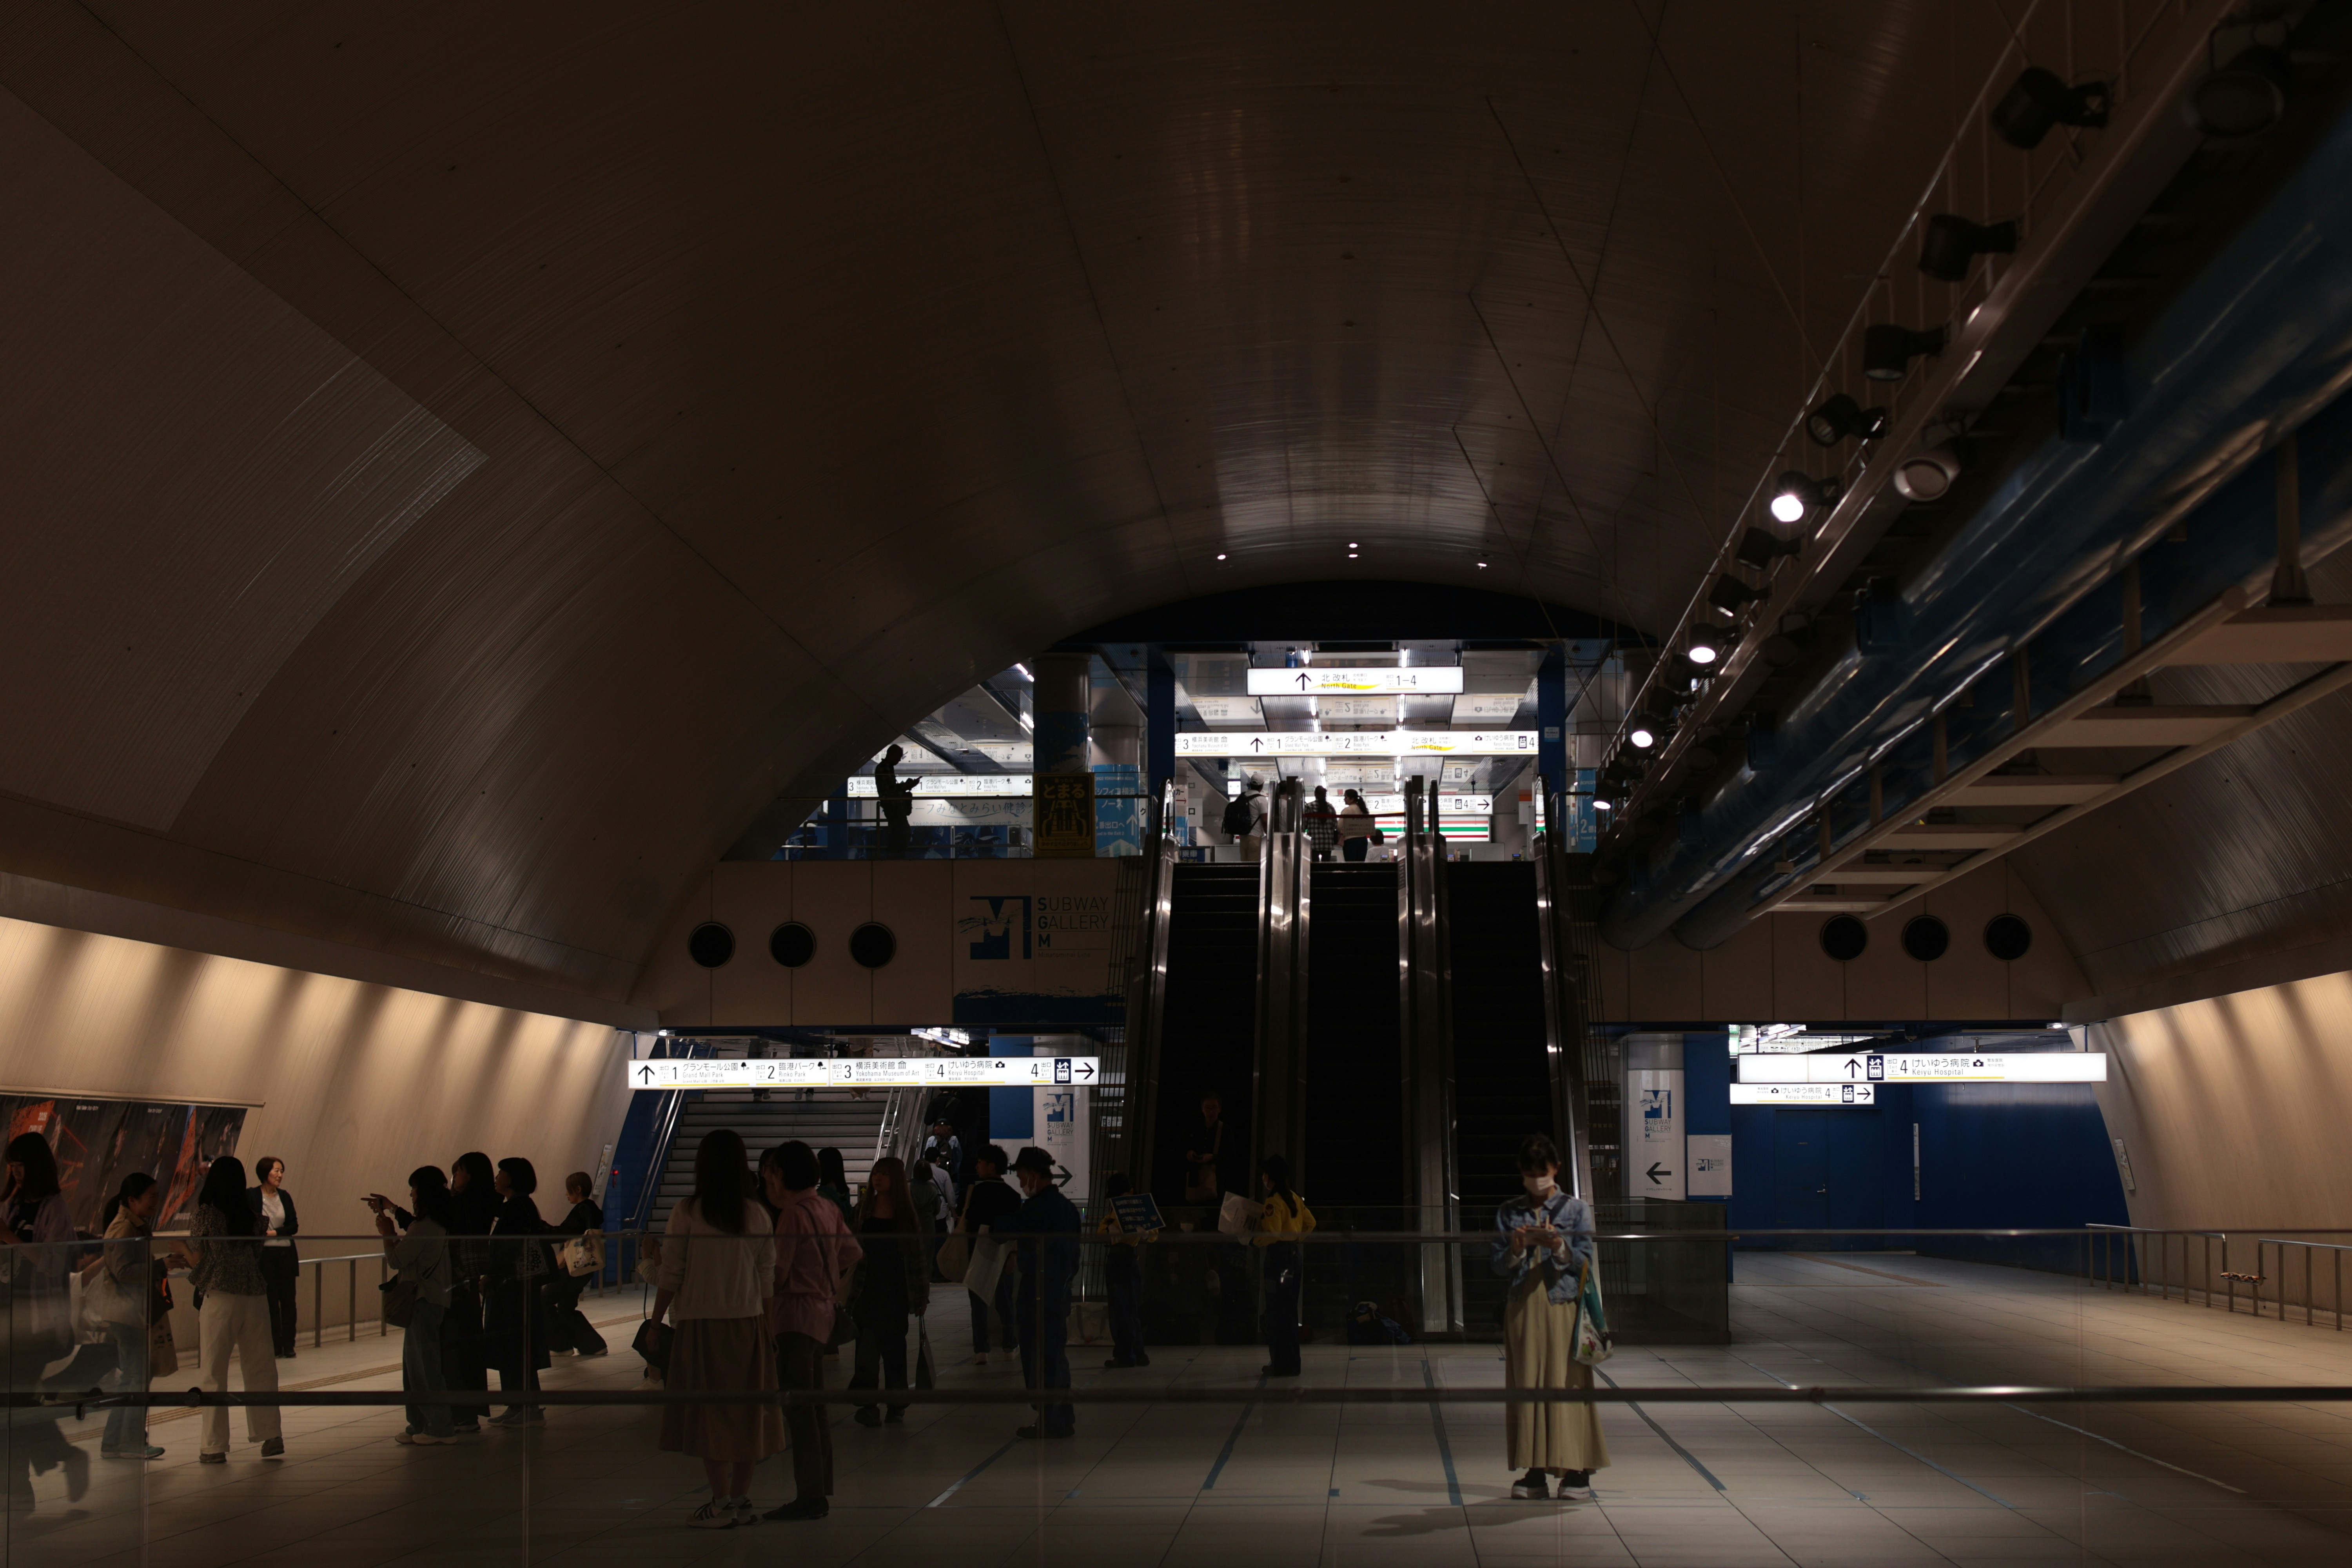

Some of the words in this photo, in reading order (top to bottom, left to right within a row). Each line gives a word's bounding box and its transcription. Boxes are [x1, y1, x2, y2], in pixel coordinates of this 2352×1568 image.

[1183, 739, 1188, 749] 3
[1277, 739, 1280, 748] 1
[1345, 739, 1350, 748] 2
[1529, 737, 1534, 747] 4
[849, 782, 854, 791] 3
[977, 781, 981, 790] 2
[1044, 783, 1085, 799] とまる
[1375, 800, 1379, 809] 2
[1038, 897, 1109, 911] SUBWAY
[1038, 915, 1108, 929] GALLERY
[1038, 934, 1050, 948] M
[1900, 1060, 1908, 1073] 4
[1913, 1059, 1969, 1067] けいゆう病院
[673, 1067, 676, 1080] 1
[768, 1066, 774, 1079] 2
[845, 1065, 851, 1078] 3
[937, 1065, 944, 1077] 4
[1031, 1063, 1038, 1077] 4
[1826, 1088, 1830, 1098] 4
